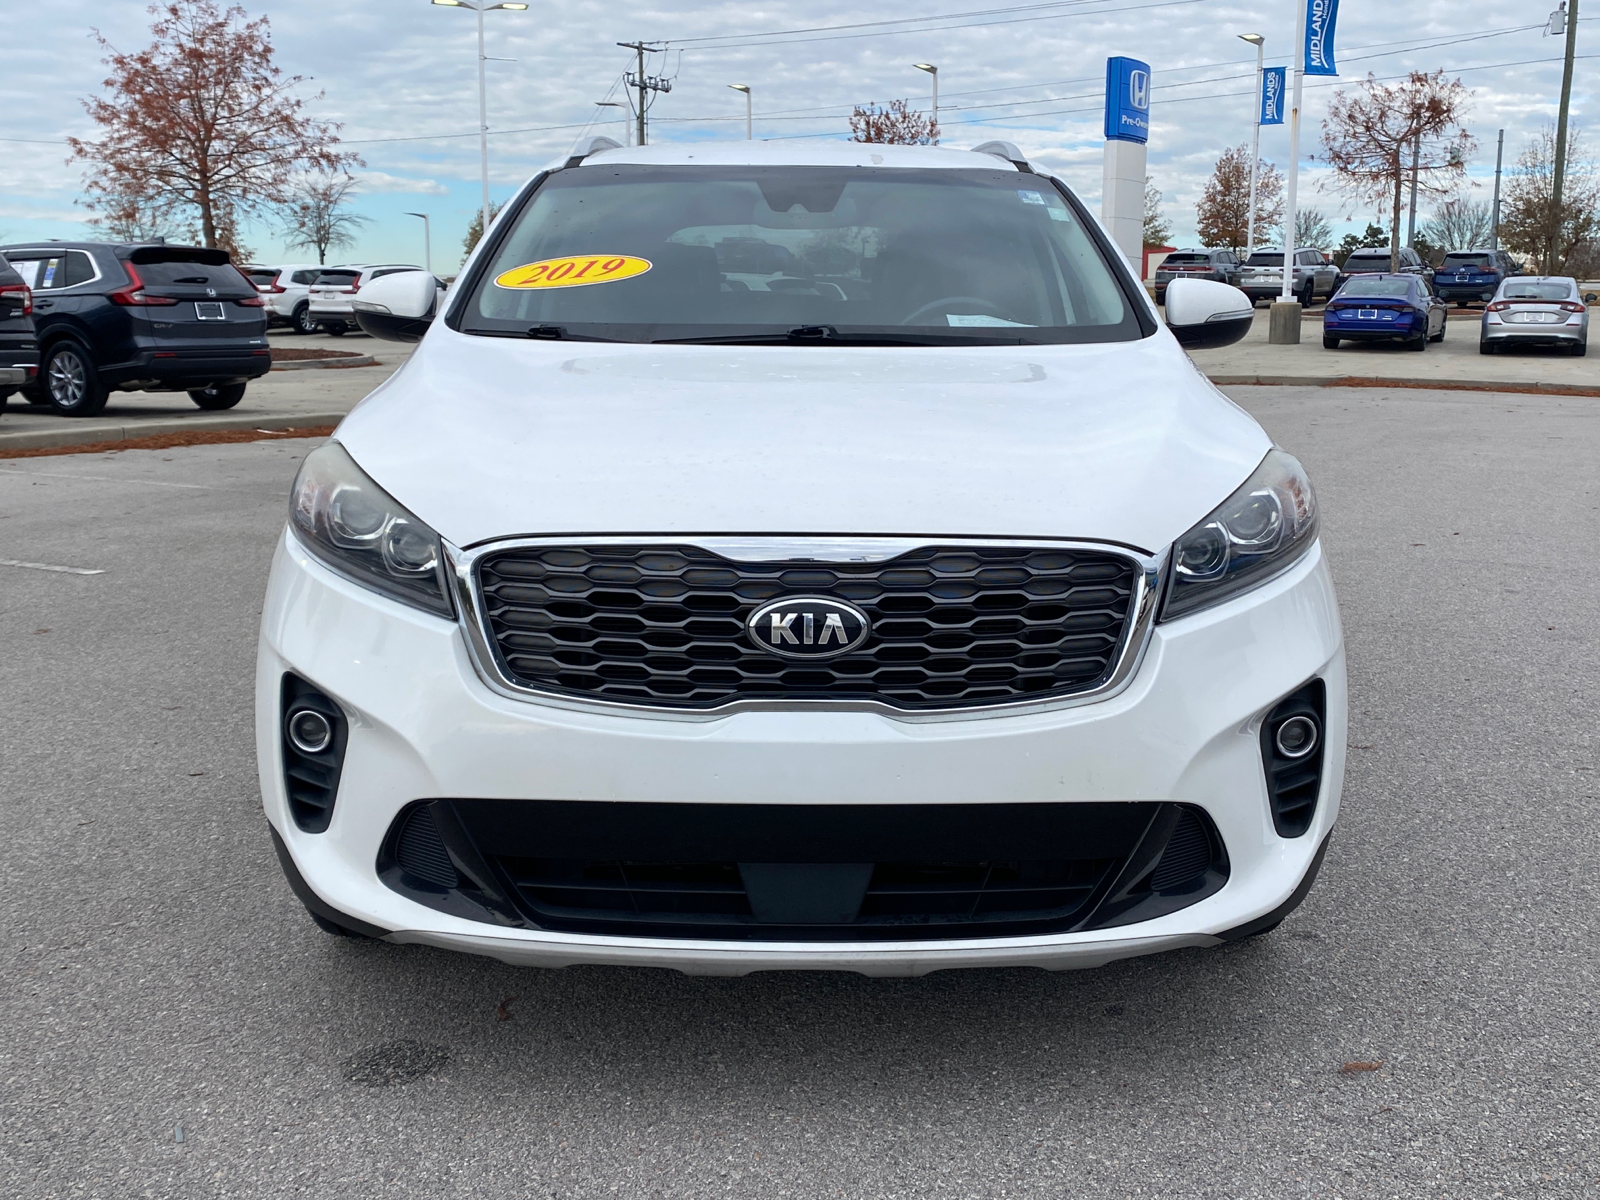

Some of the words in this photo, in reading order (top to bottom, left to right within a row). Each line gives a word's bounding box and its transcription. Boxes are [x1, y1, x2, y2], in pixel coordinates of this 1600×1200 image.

[1322, 0, 1330, 19] Hond
[1310, 0, 1324, 66] MIDLAND
[1265, 71, 1276, 119] MIDLANDS
[516, 258, 626, 285] 2019
[769, 612, 849, 645] KIA
